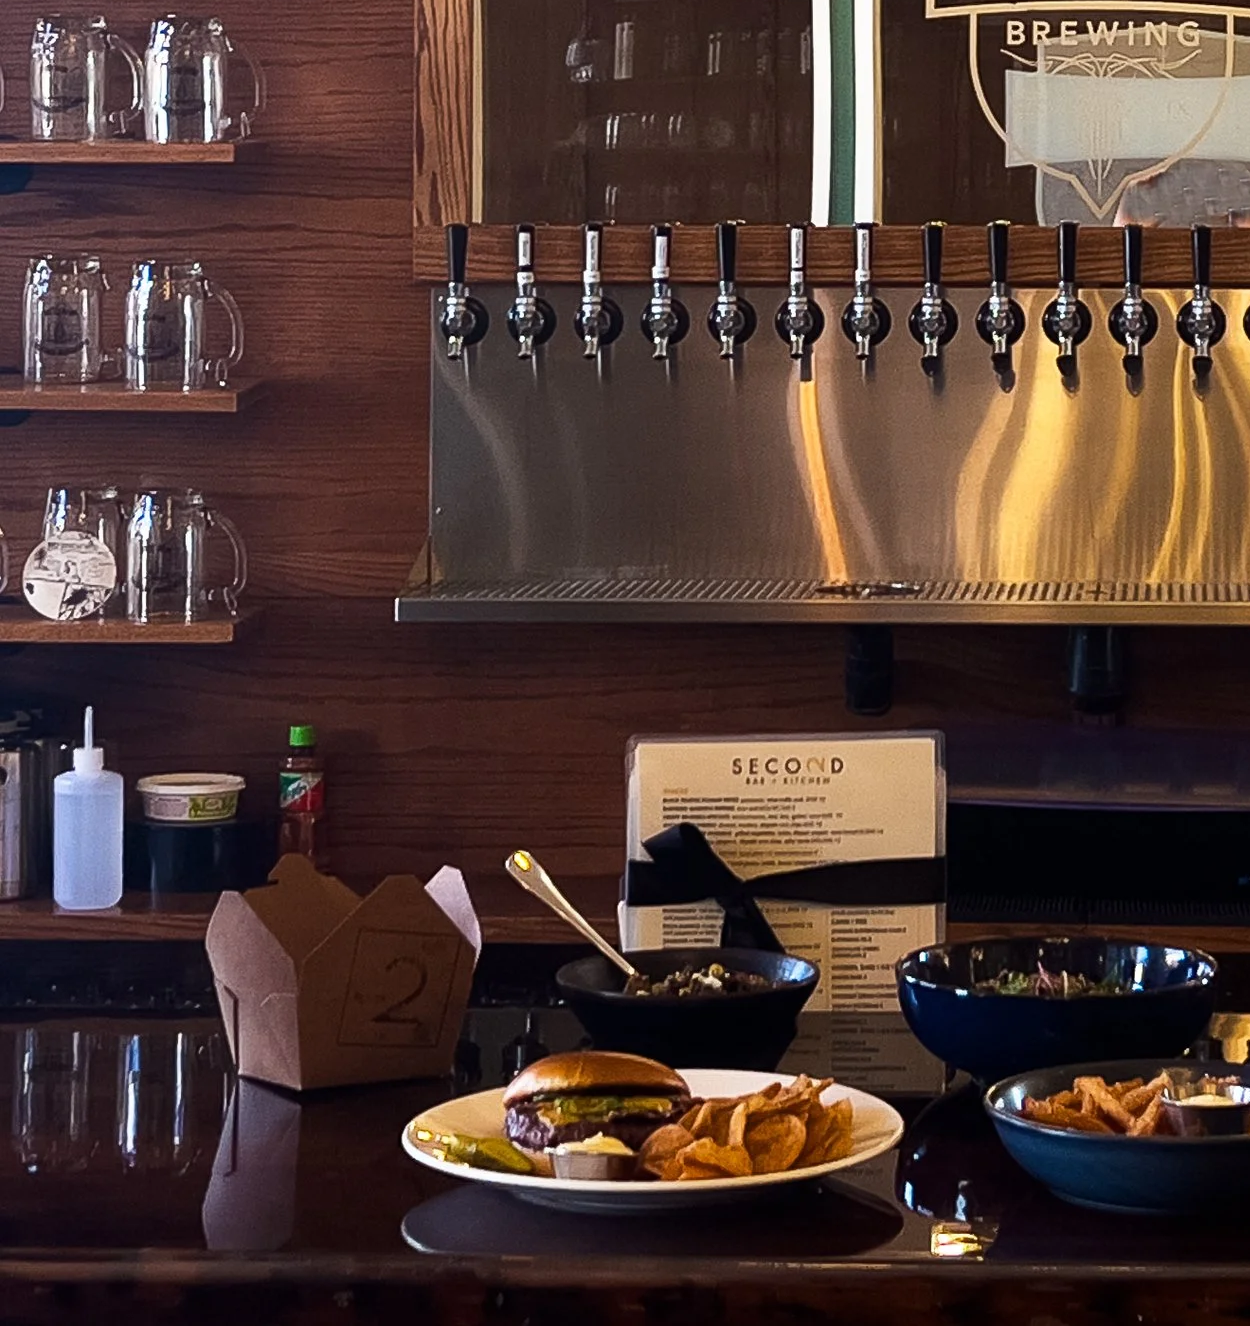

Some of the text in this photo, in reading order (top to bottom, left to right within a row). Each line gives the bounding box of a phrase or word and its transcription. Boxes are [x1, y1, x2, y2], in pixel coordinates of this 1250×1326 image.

[1006, 20, 1200, 46] BREWING
[732, 757, 844, 775] SECOND
[370, 955, 428, 1025] 2
